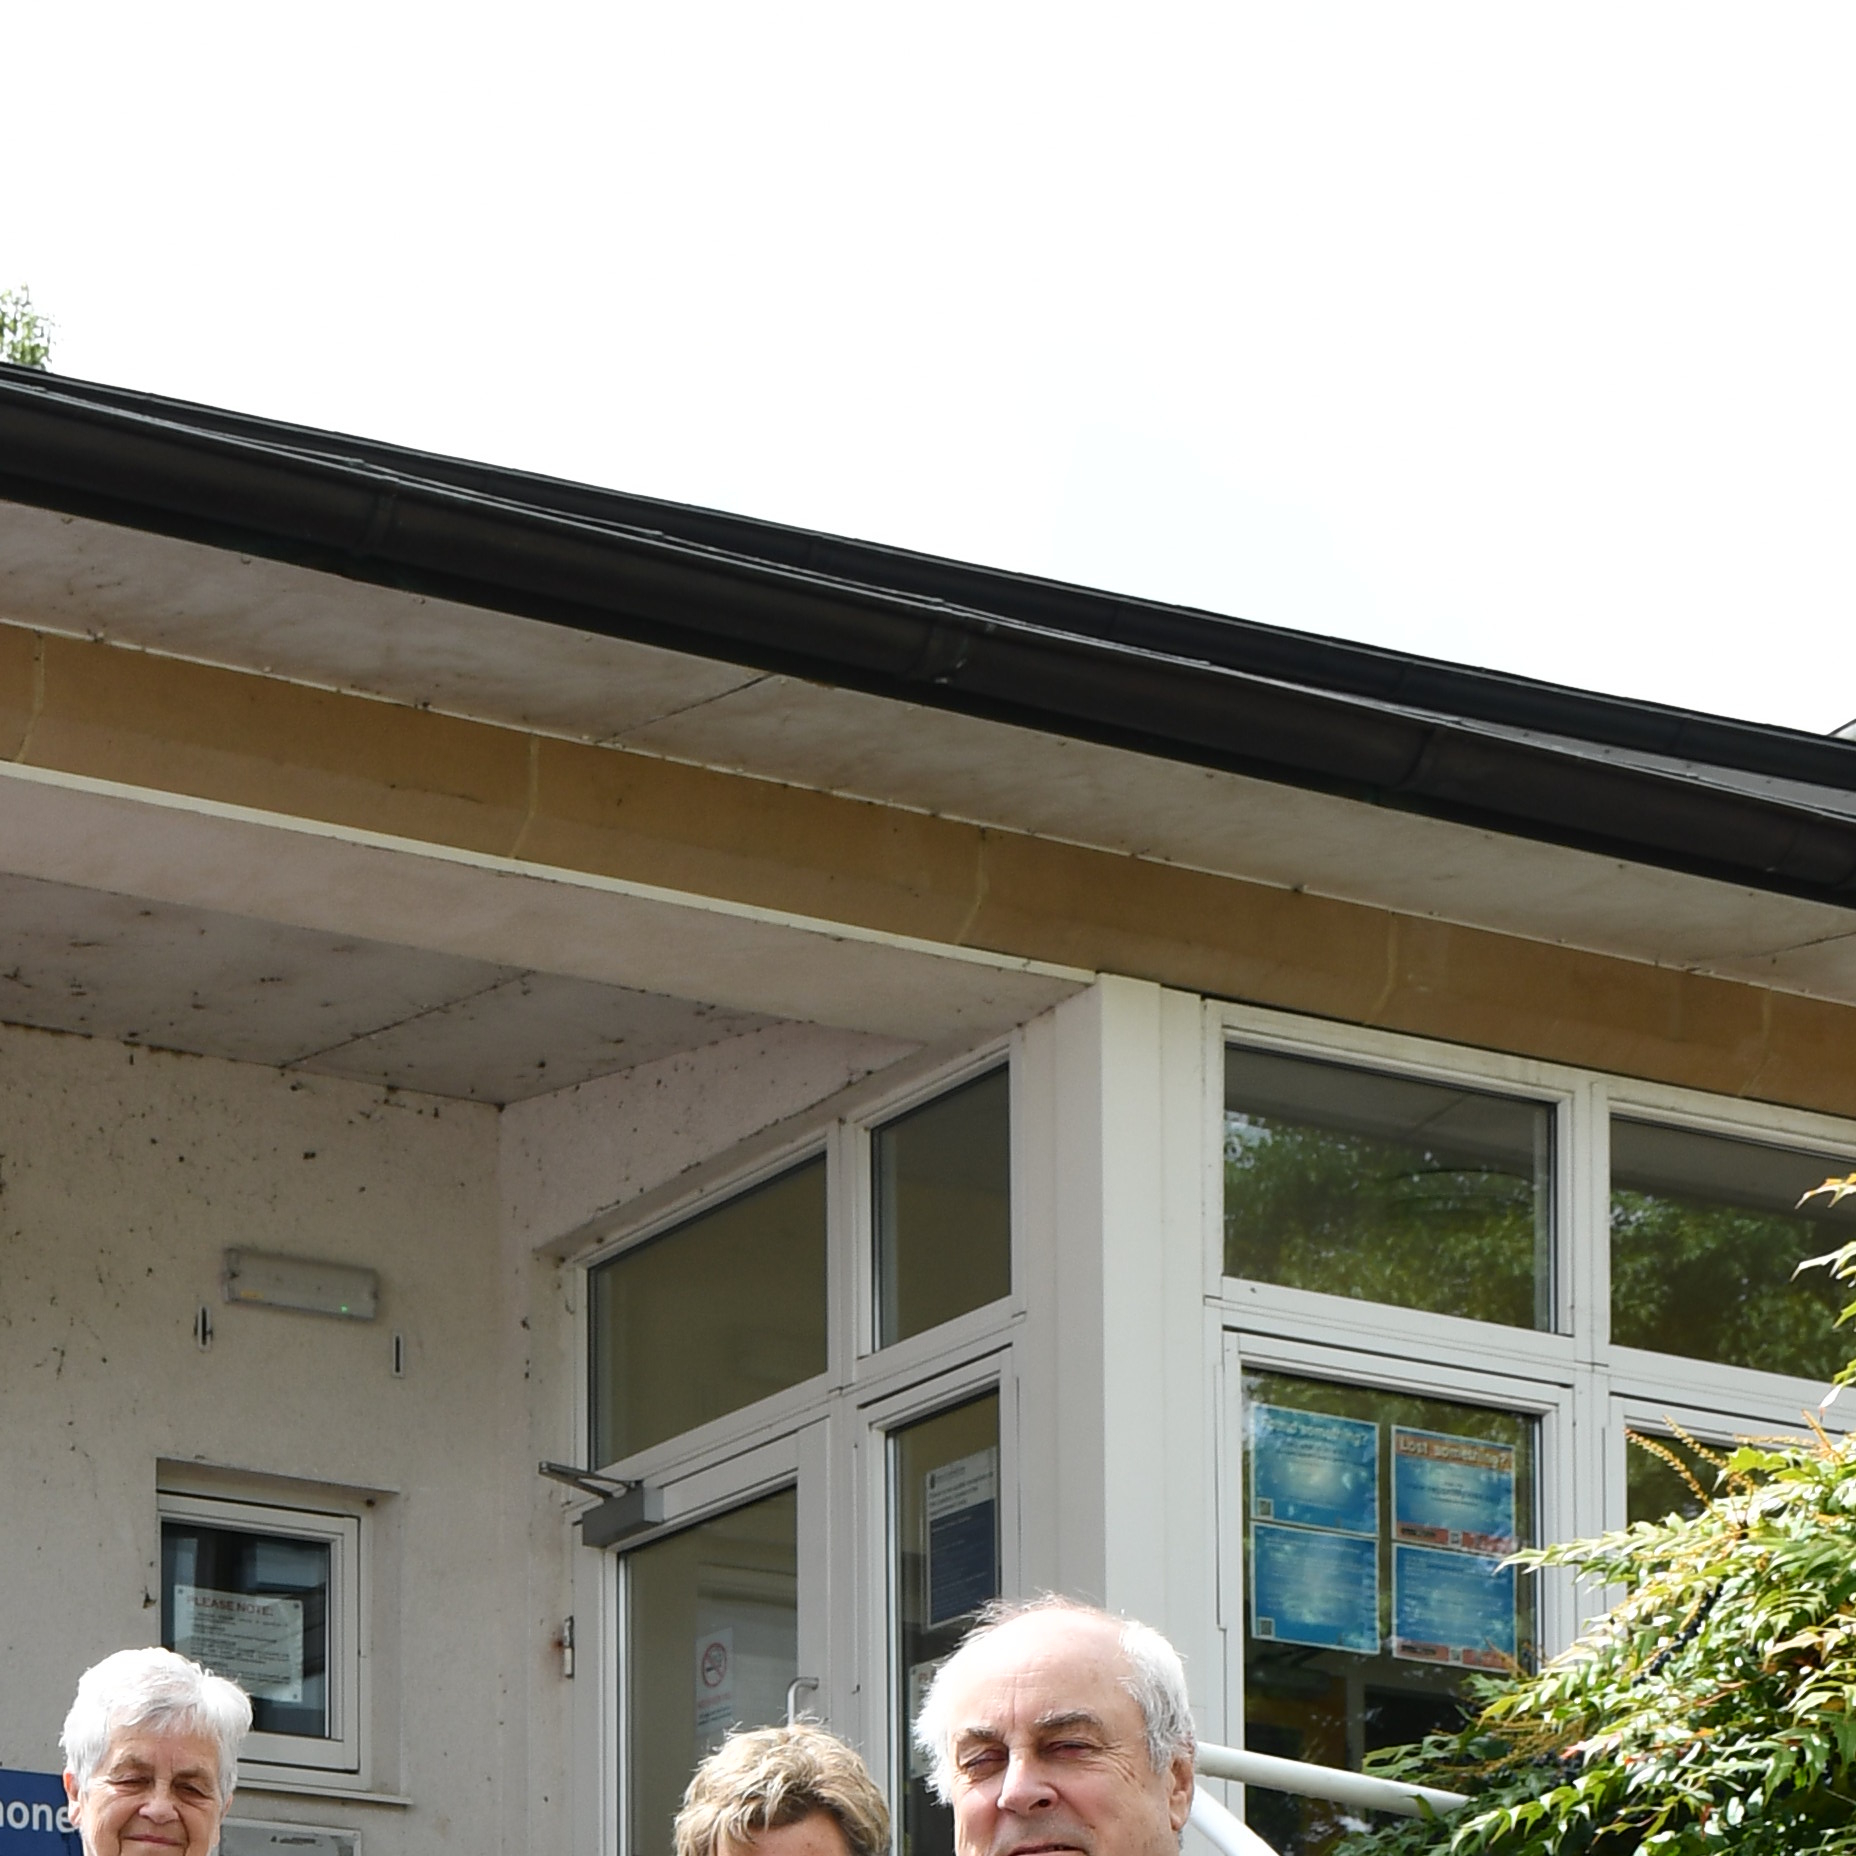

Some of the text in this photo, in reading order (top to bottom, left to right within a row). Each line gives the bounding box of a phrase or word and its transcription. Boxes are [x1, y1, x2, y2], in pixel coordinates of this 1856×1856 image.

[1399, 1436, 1508, 1469] Lost something?
[187, 1595, 234, 1612] PLEASE
